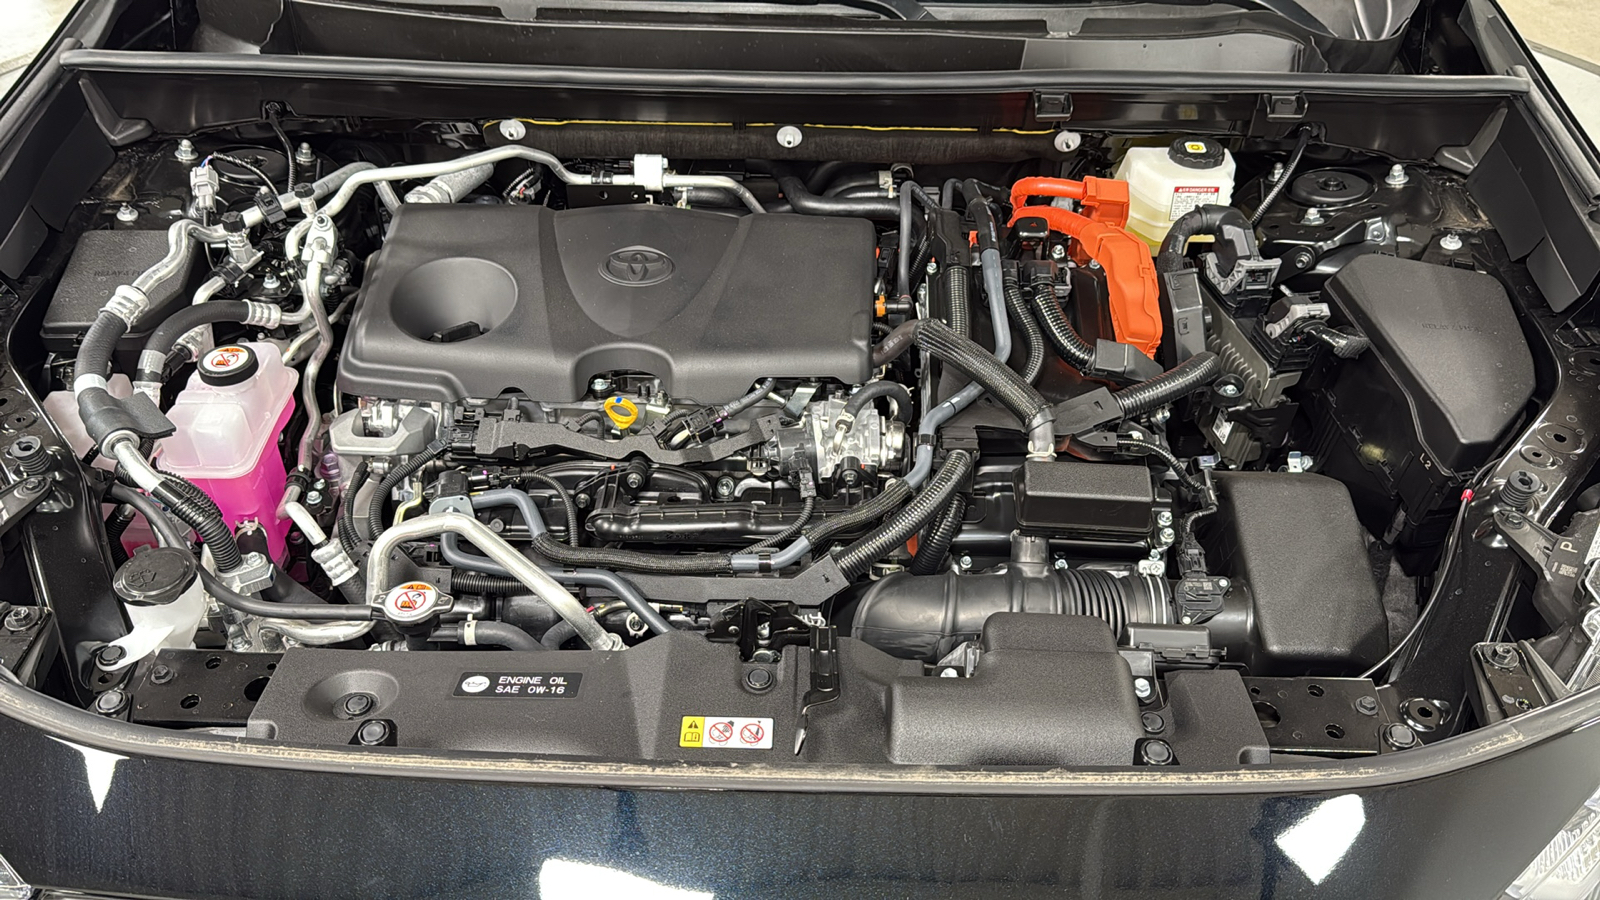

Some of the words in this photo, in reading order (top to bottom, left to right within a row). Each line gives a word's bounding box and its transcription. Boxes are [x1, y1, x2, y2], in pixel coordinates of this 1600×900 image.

[1559, 541, 1578, 554] P
[498, 676, 542, 684] ENGINE
[549, 676, 568, 685] OIL
[495, 685, 520, 693] SAE
[527, 686, 565, 694] 0W-16
